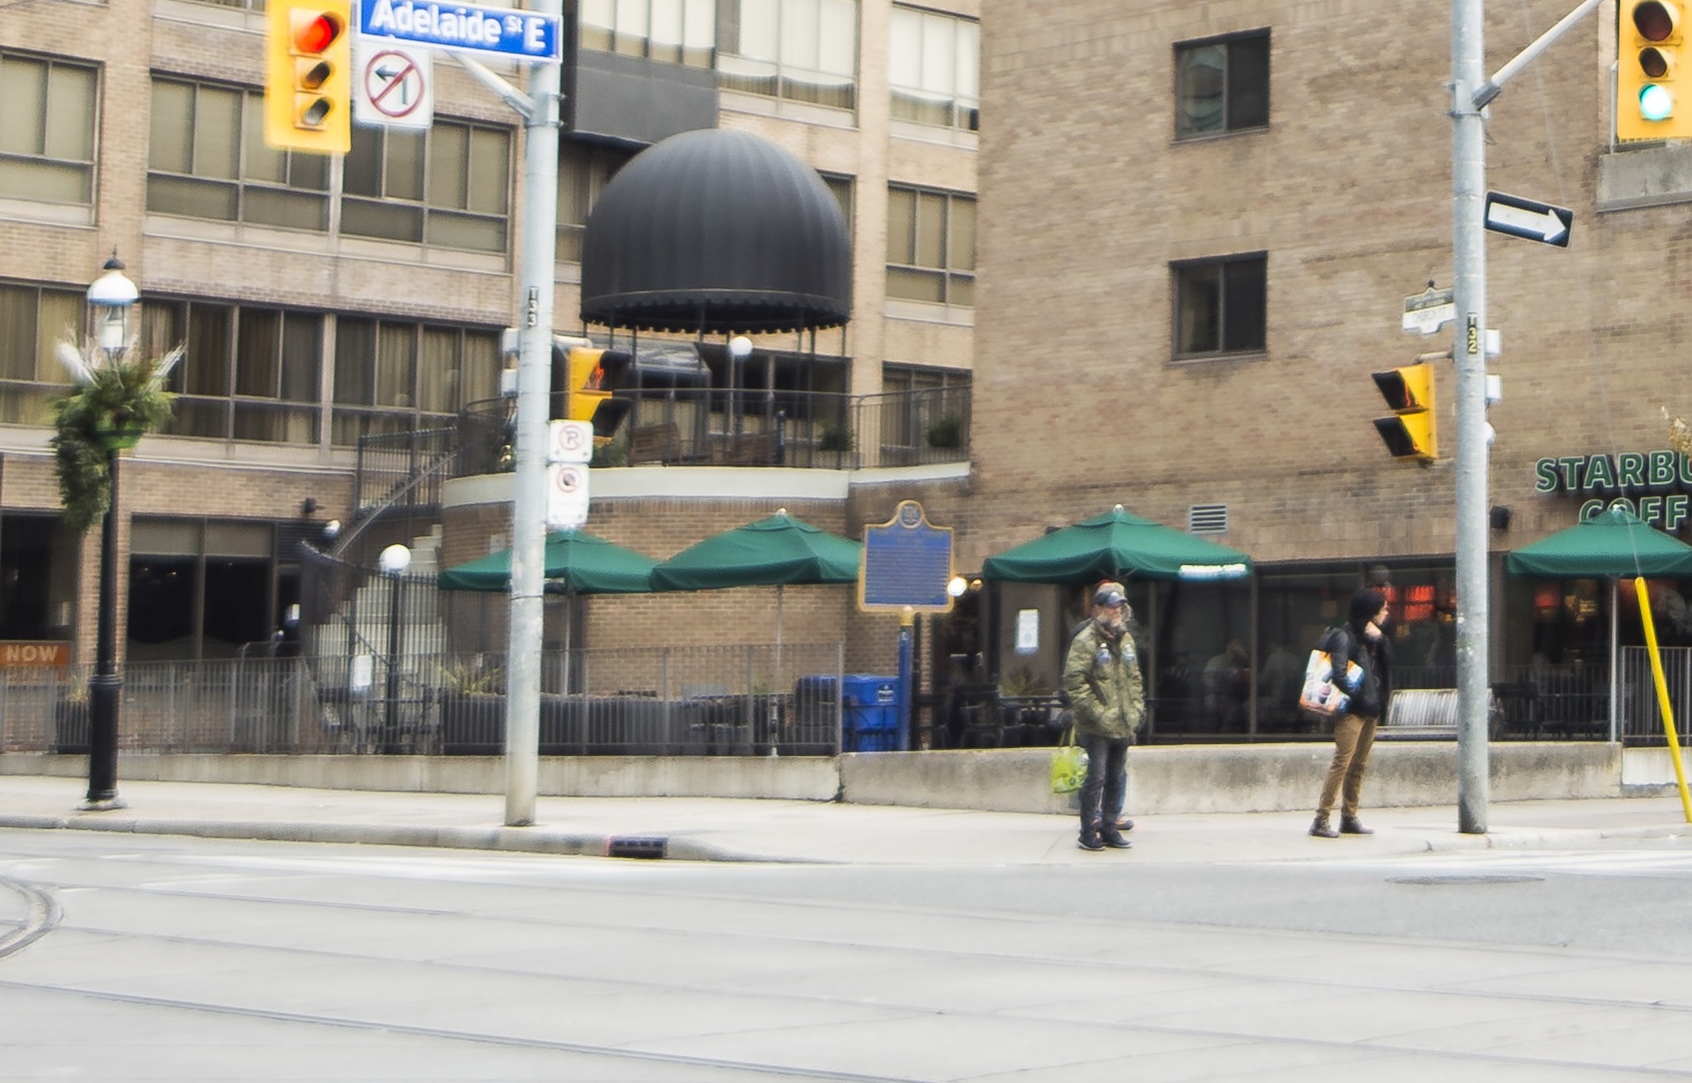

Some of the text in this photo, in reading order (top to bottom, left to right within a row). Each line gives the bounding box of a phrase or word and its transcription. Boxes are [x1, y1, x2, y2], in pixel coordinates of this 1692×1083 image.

[504, 15, 523, 33] St
[525, 18, 547, 49] E
[1467, 313, 1477, 352] T32
[6, 644, 59, 662] NOW
